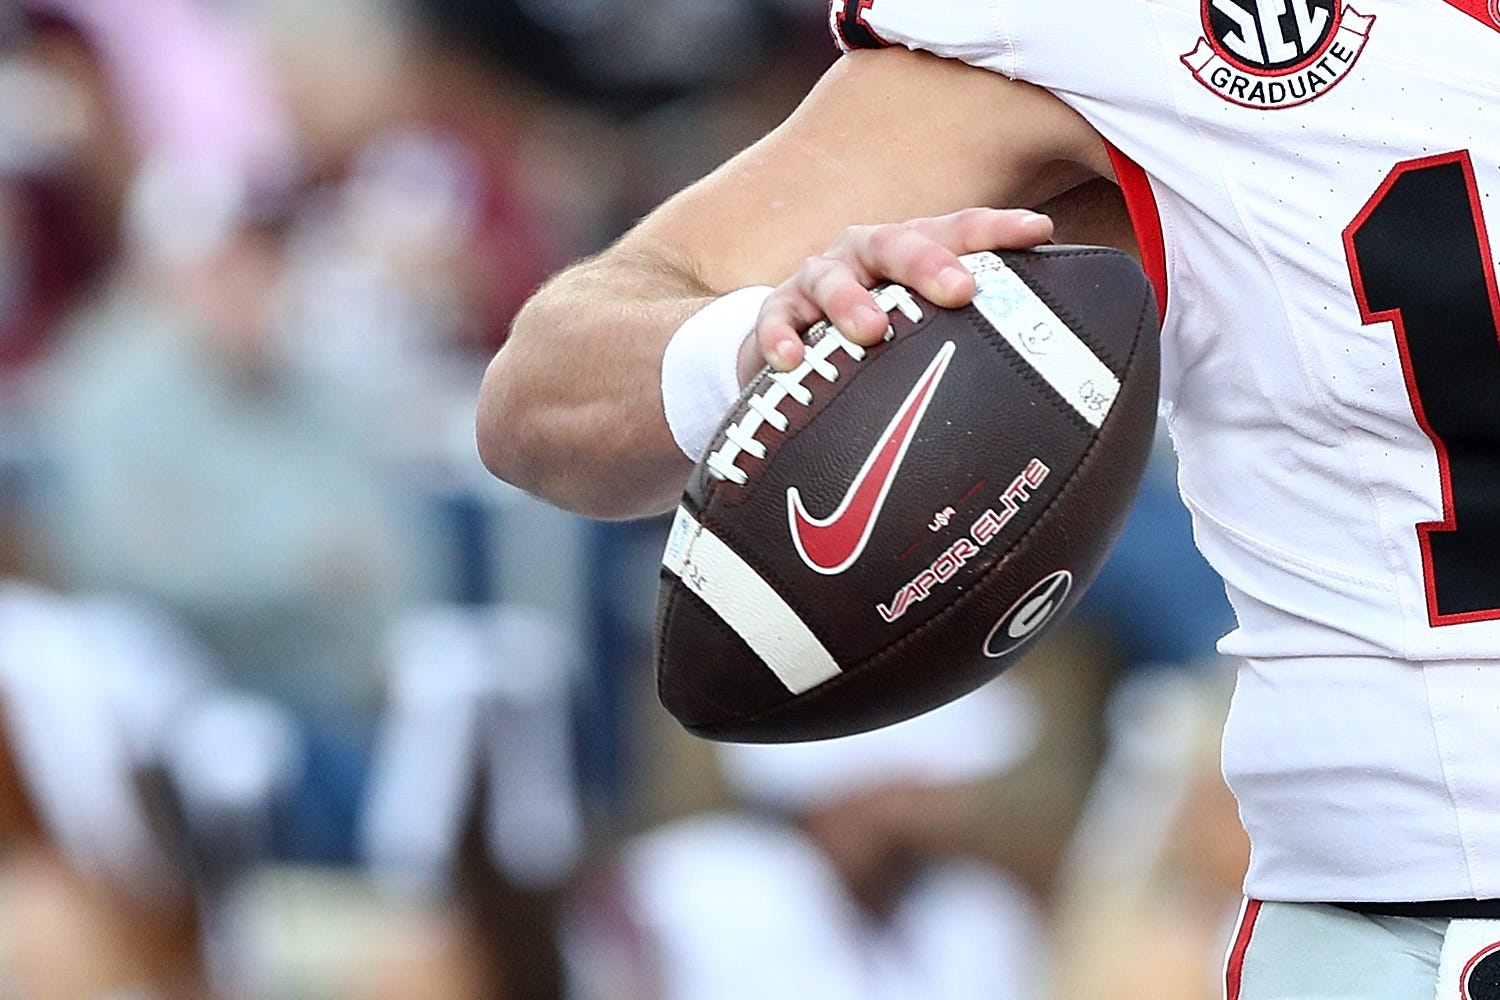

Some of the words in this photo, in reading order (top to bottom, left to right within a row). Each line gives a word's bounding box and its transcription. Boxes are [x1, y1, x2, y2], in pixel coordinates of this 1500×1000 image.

[1210, 41, 1353, 103] GRADUATE
[876, 538, 980, 622] VAPOR
[970, 458, 1050, 545] ELITE
